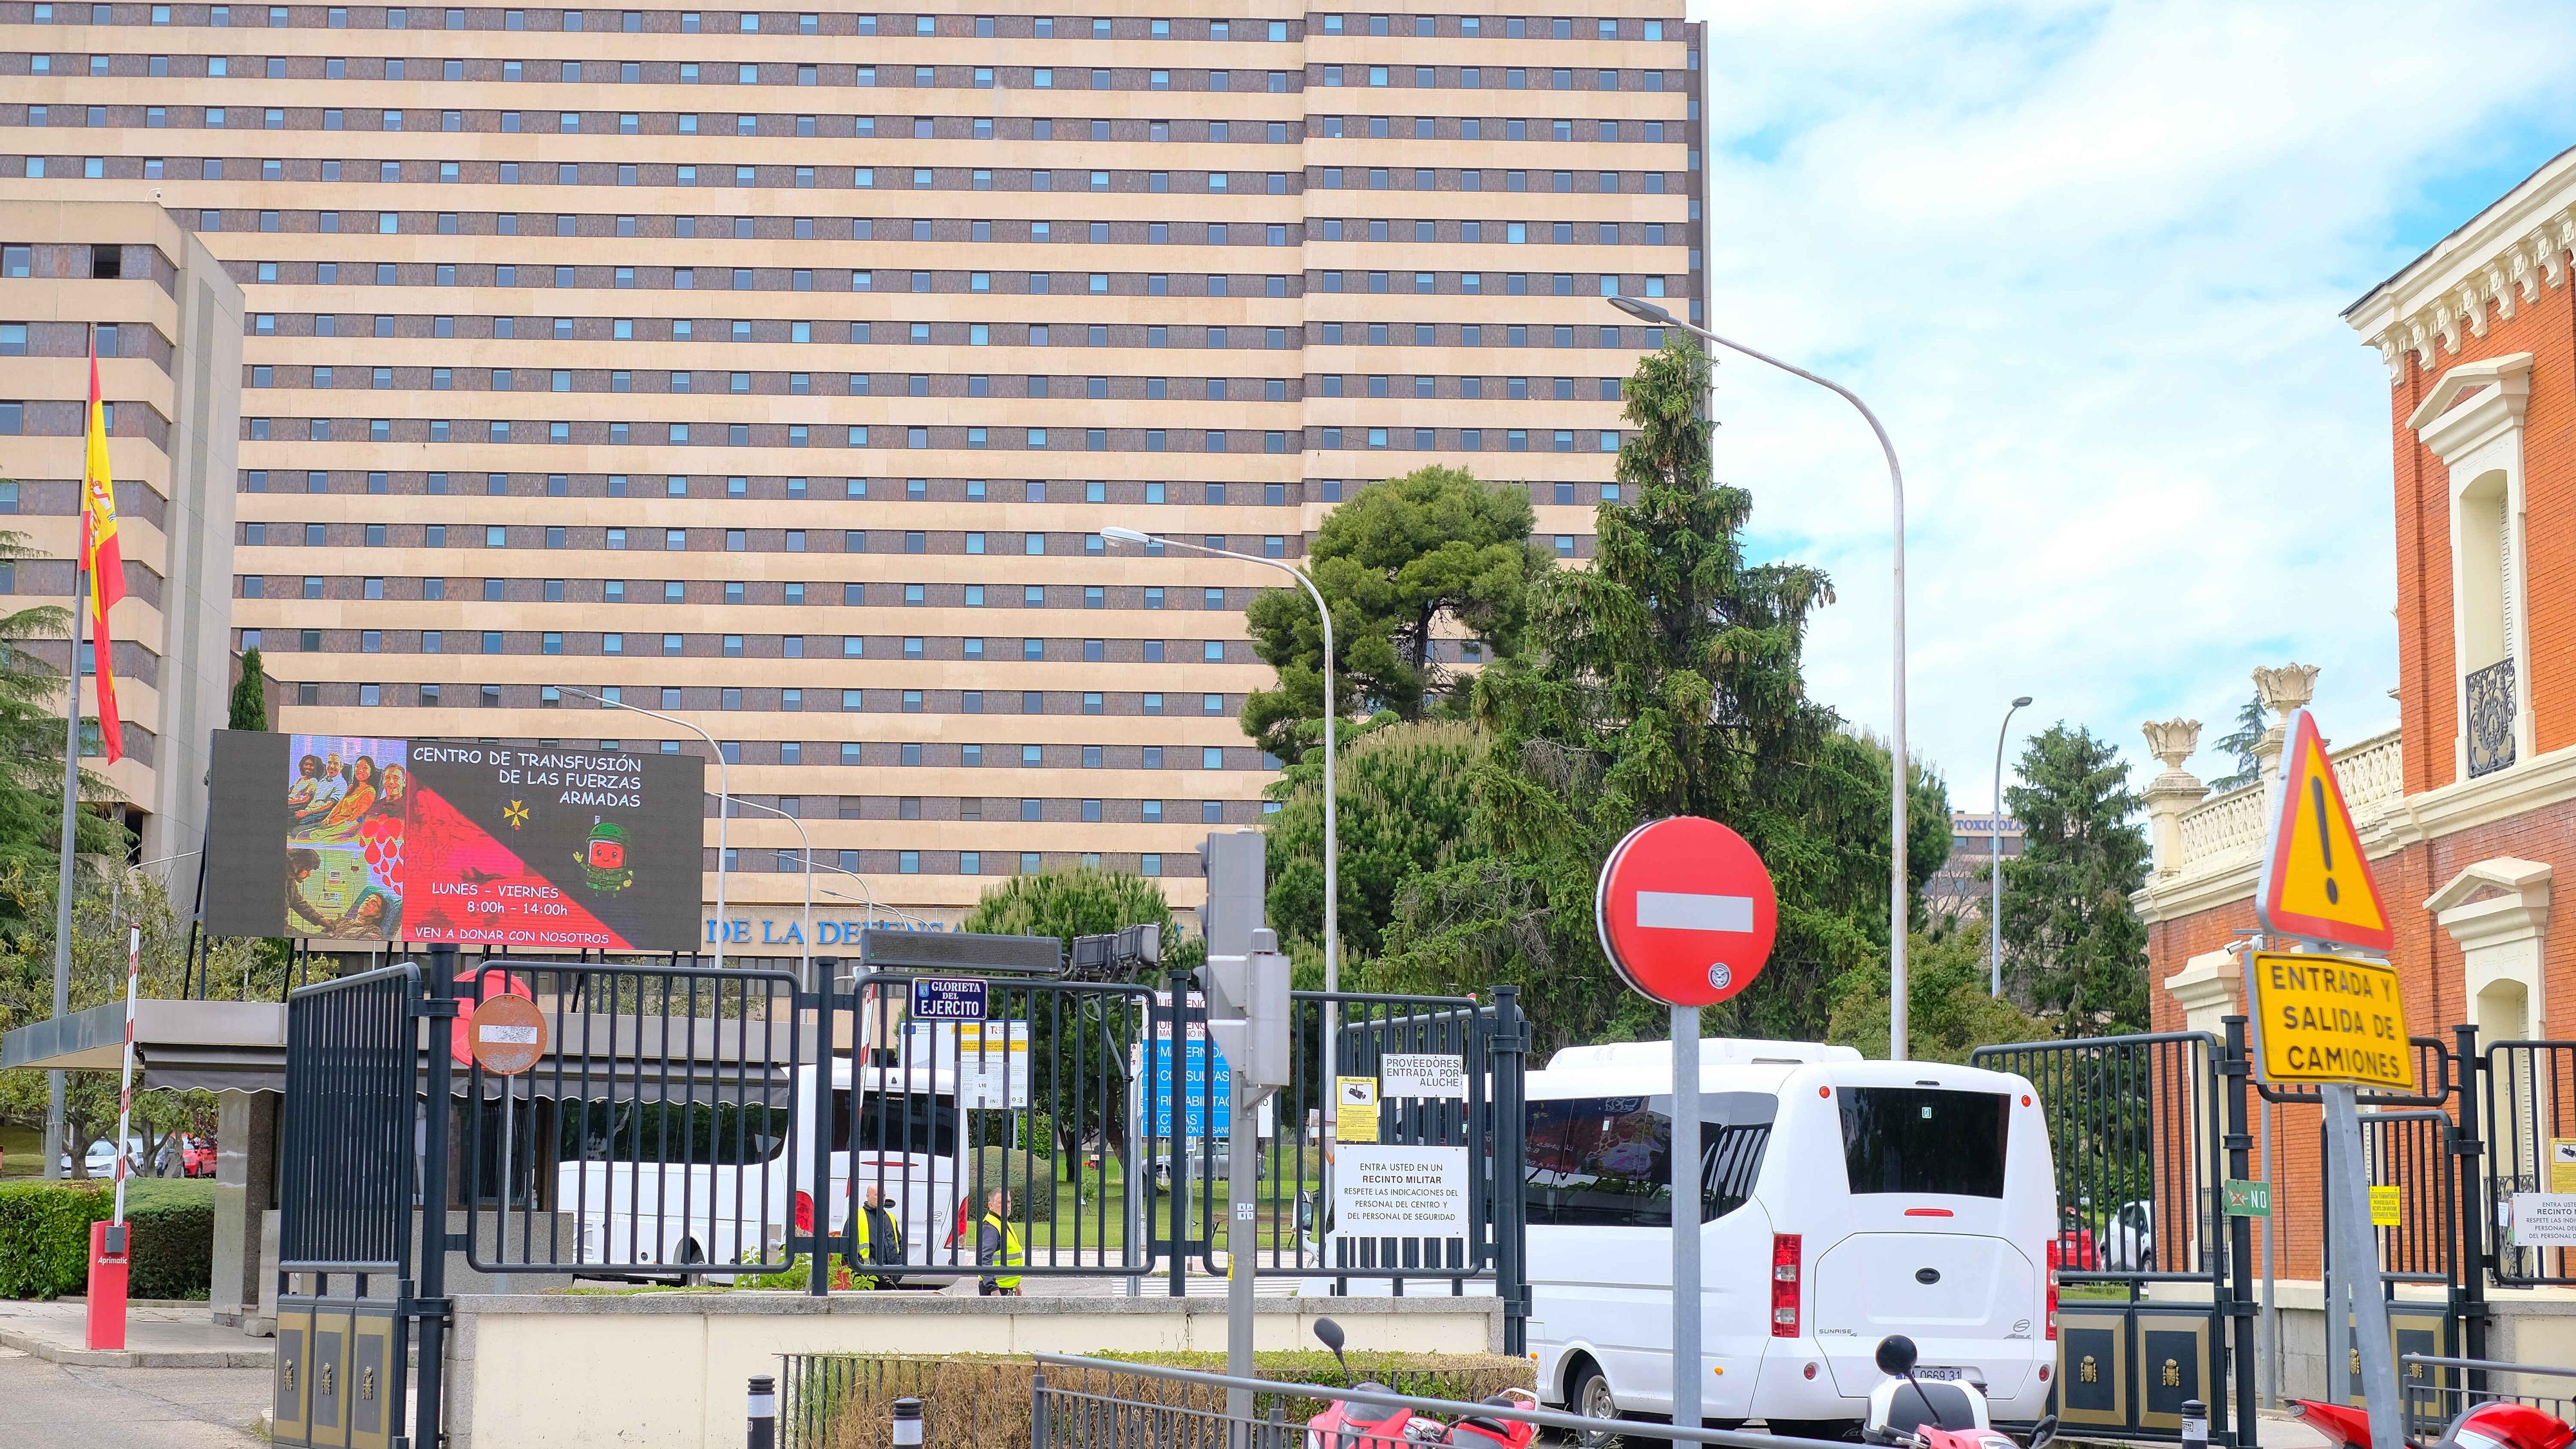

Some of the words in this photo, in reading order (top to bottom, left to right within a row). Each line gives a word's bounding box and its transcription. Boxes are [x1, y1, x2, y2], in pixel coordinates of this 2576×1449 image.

[413, 747, 482, 764] CENTRO
[489, 751, 511, 766] DE
[518, 752, 641, 773] TRANSFUSIÓN
[499, 770, 520, 784] DE
[527, 771, 559, 786] LAS
[565, 773, 641, 790] FUERZAS
[559, 791, 641, 807] ARMADAS
[432, 882, 478, 895] LUNES
[498, 885, 559, 898] VIERNES
[467, 901, 505, 913] 8:00h
[523, 903, 567, 916] 14:00h
[415, 927, 441, 938] VEN
[446, 929, 454, 938] A
[460, 929, 504, 940] DONAR
[509, 931, 535, 942] CON
[540, 931, 609, 944] NOSOTROS
[706, 918, 752, 943] DE
[762, 920, 805, 944] LA
[931, 981, 981, 992] GLORIETA
[2271, 965, 2374, 999] ENTRADA
[2380, 978, 2391, 1002] Y
[921, 1000, 979, 1016] EJERCITO
[2283, 1005, 2365, 1036] SALIDA
[2372, 1014, 2395, 1041] DE
[1387, 1059, 1459, 1068] PROVEEDORES
[2288, 1045, 2400, 1078] CAMIONES
[1387, 1068, 1433, 1077] ENTRADA
[1440, 1069, 1459, 1077] POR
[1420, 1078, 1459, 1086] ALUCHE
[2251, 1189, 2267, 1208] NO
[98, 1256, 128, 1265] Aprimatic
